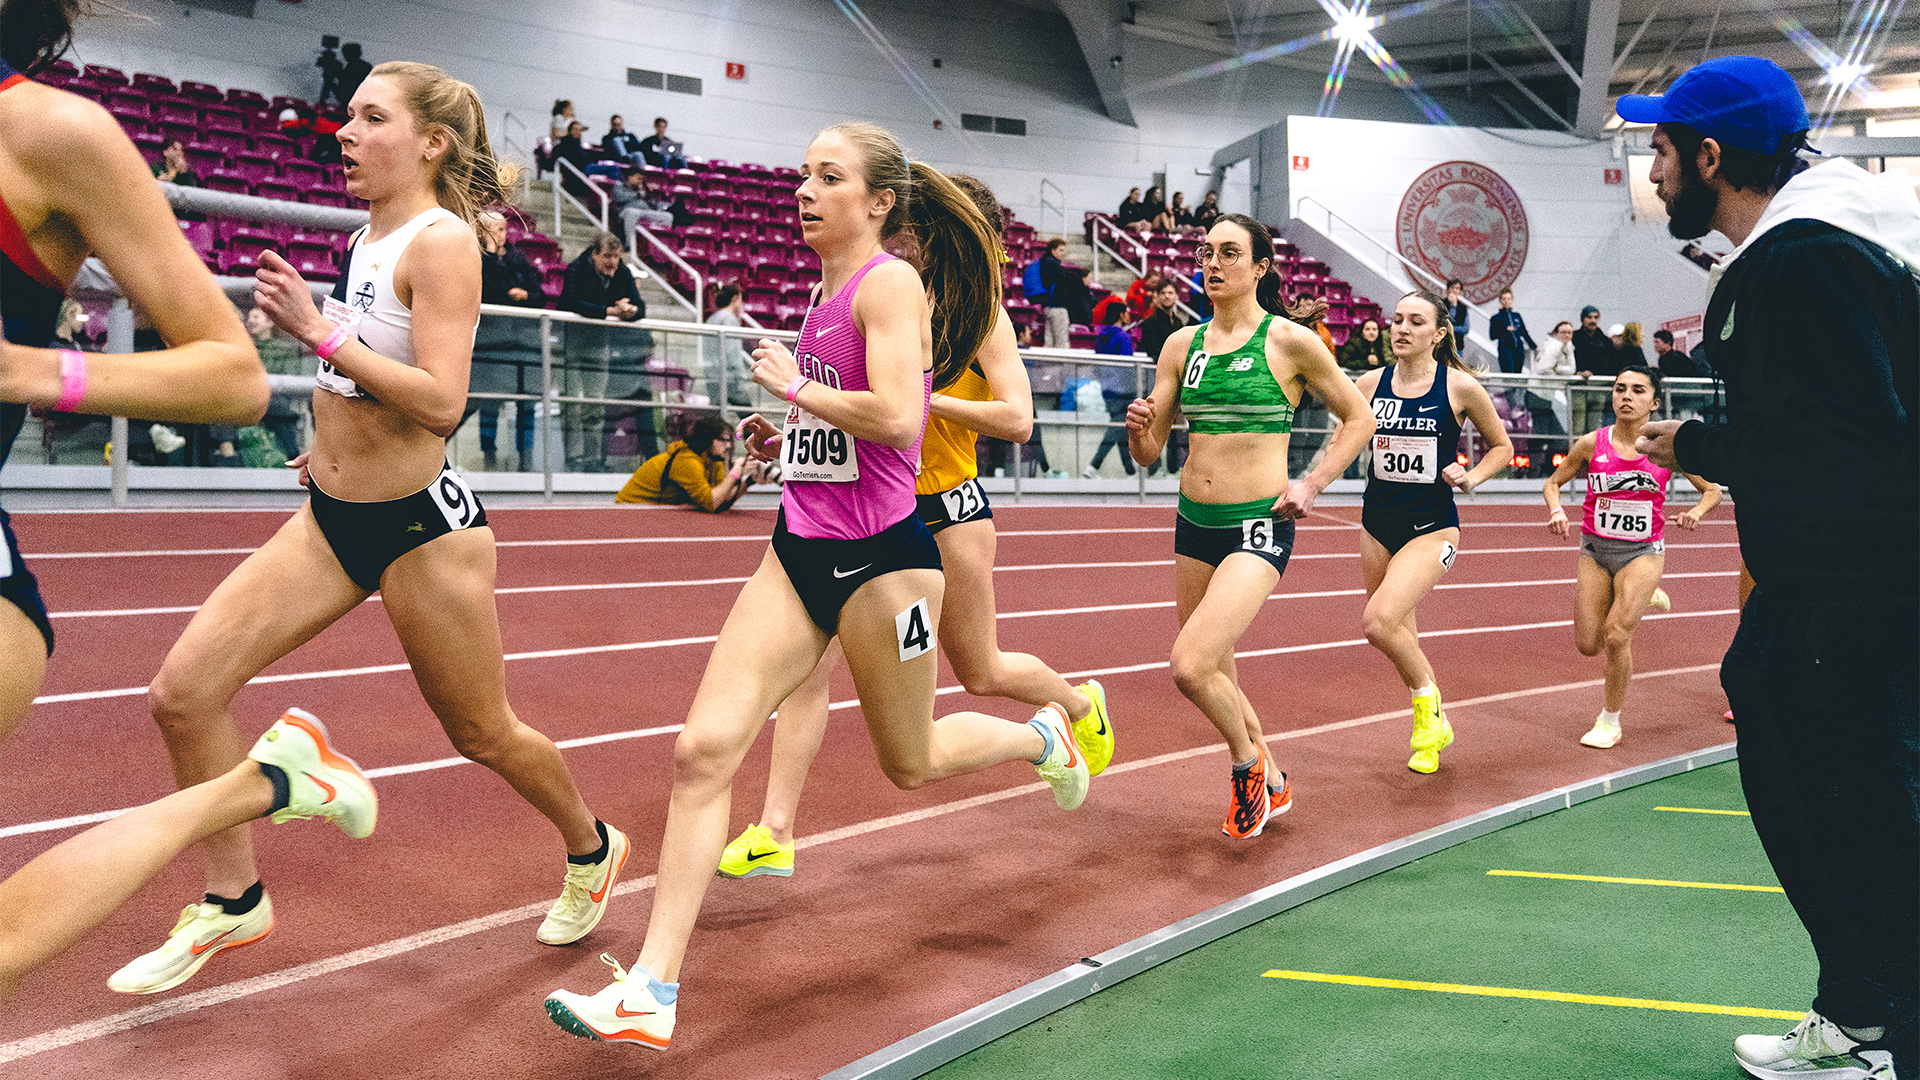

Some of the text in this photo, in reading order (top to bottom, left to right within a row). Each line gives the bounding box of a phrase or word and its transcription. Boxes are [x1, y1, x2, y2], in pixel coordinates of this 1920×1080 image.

[1402, 167, 1453, 233] UNIVERSITAS
[1188, 353, 1206, 386] 6
[1375, 399, 1397, 420] 20
[787, 428, 848, 466] 1509
[1383, 452, 1425, 474] 304
[440, 476, 470, 527] 9
[950, 482, 979, 520] 23
[1250, 521, 1267, 549] 6
[1599, 512, 1647, 532] 1785
[903, 604, 930, 652] 4
